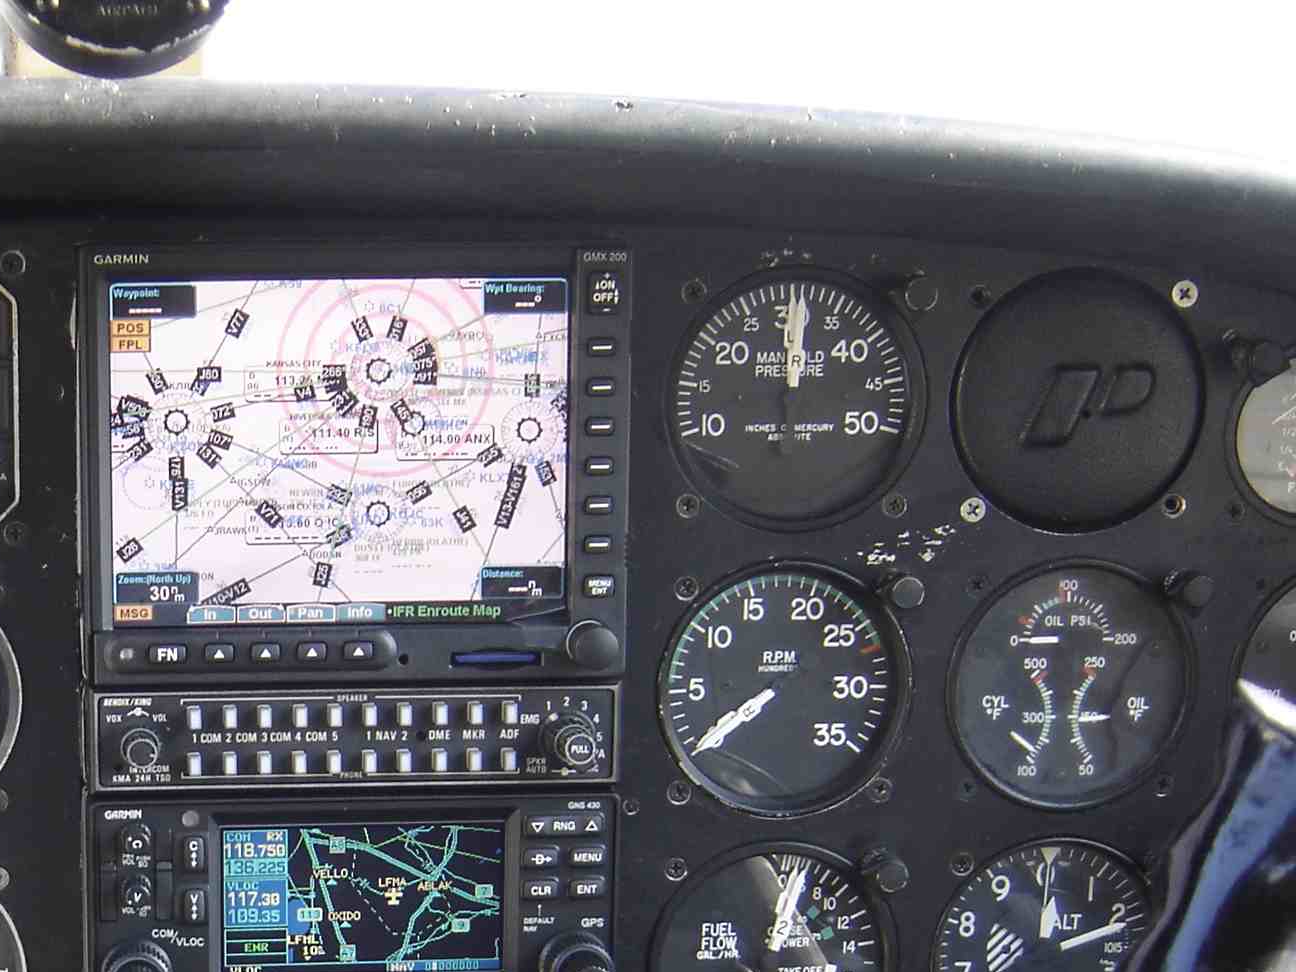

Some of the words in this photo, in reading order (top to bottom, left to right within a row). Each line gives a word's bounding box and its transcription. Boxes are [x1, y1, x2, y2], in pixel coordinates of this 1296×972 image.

[94, 254, 149, 264] GARMIN
[584, 252, 606, 262] GMX
[609, 252, 627, 261] 200
[593, 293, 612, 302] OFF
[117, 323, 143, 333] POS
[119, 340, 142, 350] FPL
[715, 341, 749, 365] 20
[831, 339, 869, 363] 40
[702, 414, 725, 436] 10
[844, 412, 878, 434] 50
[483, 569, 523, 578] Distance:
[120, 607, 149, 618] MSG
[204, 608, 216, 620] In
[249, 609, 272, 619] Out
[298, 607, 323, 618] Pan
[348, 607, 372, 617] Info
[418, 606, 469, 617] Enroute
[473, 605, 501, 617] Map
[744, 599, 764, 620] 15
[792, 598, 824, 620] 20
[1045, 617, 1064, 626] OIL
[1071, 616, 1090, 625] PSI
[707, 626, 732, 648] 10
[823, 624, 855, 647] 25
[1114, 634, 1136, 645] 200
[158, 649, 177, 661] FN
[1024, 658, 1047, 669] 500
[833, 676, 867, 698] 30
[983, 696, 1009, 708] CYL
[1128, 698, 1149, 709] OIL
[376, 730, 397, 740] NAV
[429, 730, 451, 740] DME
[463, 730, 485, 739] MKR
[500, 729, 519, 739] ADF
[814, 723, 846, 745] 35
[105, 810, 142, 820] GARMIN
[554, 822, 575, 830] RNG
[225, 844, 285, 857] 118.750
[574, 853, 602, 862] MENU
[226, 861, 285, 874] 136.225
[314, 868, 348, 879] VELLO
[227, 881, 259, 890] VLOC
[531, 886, 551, 895] CLR
[577, 885, 597, 894] ENT
[228, 893, 279, 906] 117.30
[228, 909, 280, 922] 109.35
[581, 918, 604, 927] GPS
[703, 923, 736, 936] FUEL
[701, 937, 737, 950] FLOW
